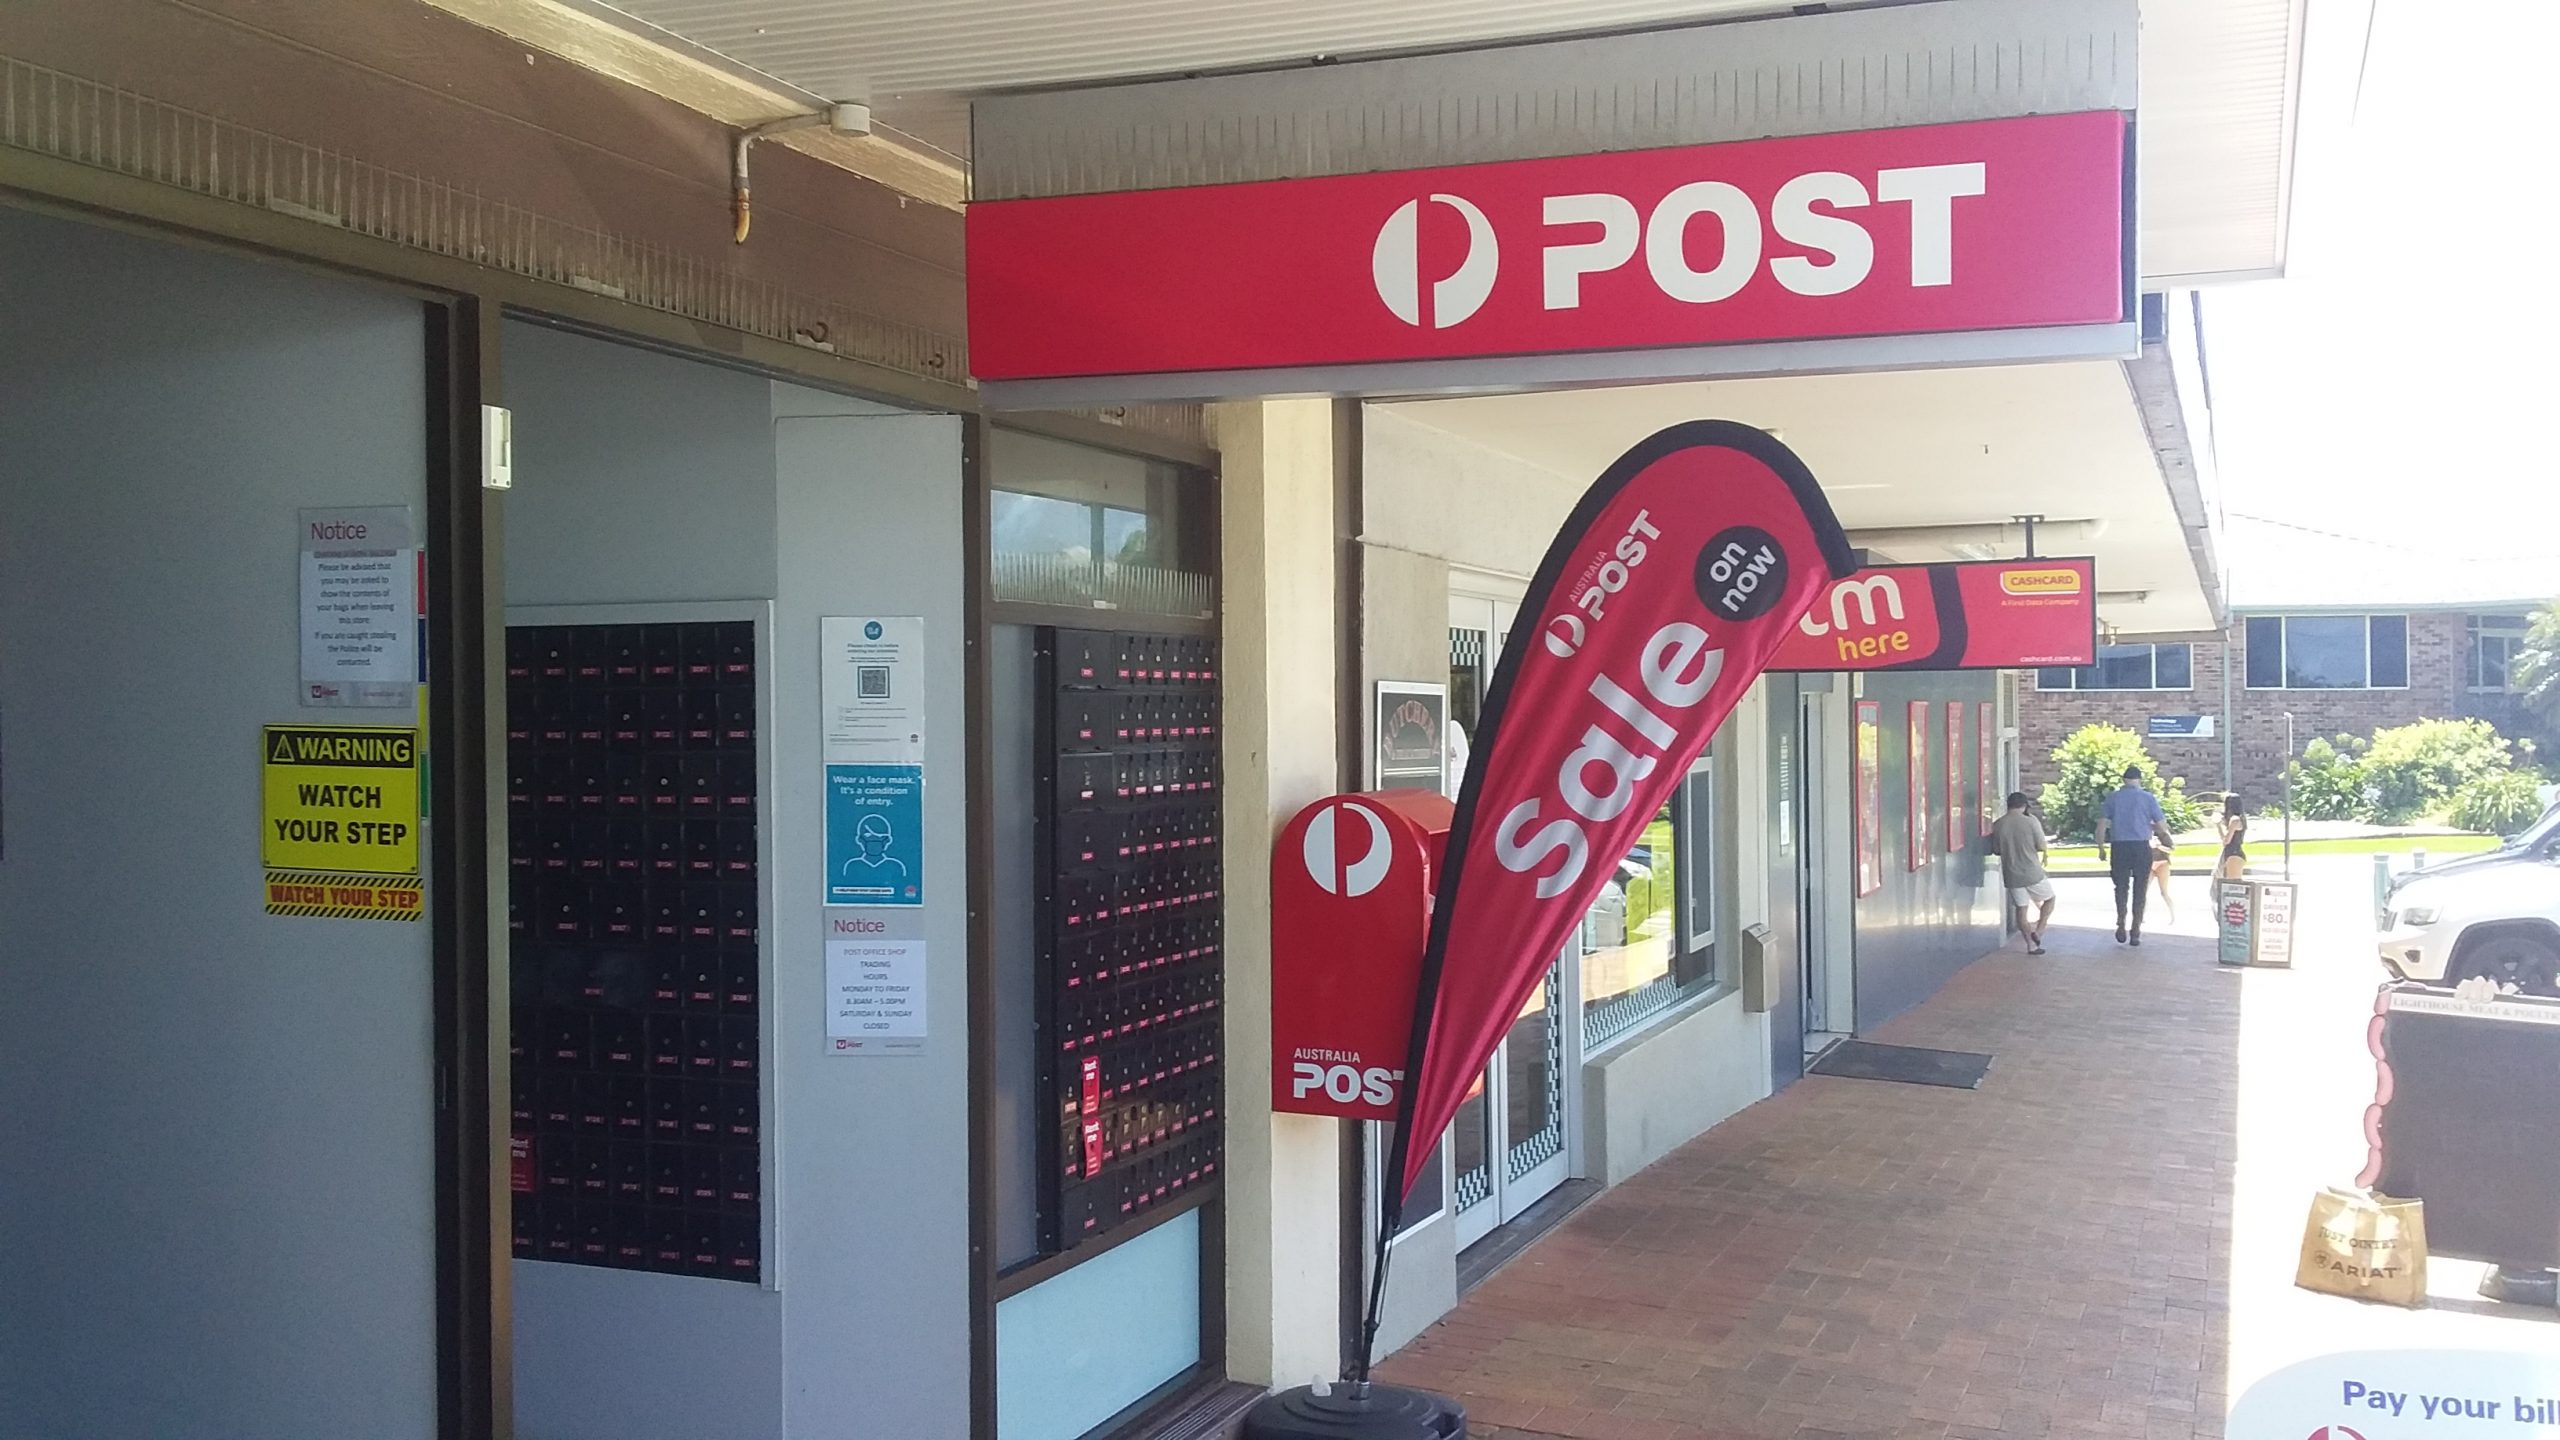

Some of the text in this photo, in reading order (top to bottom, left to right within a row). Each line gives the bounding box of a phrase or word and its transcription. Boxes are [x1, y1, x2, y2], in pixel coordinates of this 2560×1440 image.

[1543, 162, 1986, 311] POST
[311, 521, 366, 540] Notice
[1577, 509, 1661, 622] POST
[1709, 542, 1748, 583] on
[1568, 551, 1608, 603] AUSTRALIA
[1721, 544, 1777, 613] now
[2010, 575, 2074, 586] CASHCARD
[1837, 630, 1910, 661] here
[296, 736, 411, 763] WARNING
[1495, 621, 1725, 900] Sale
[833, 775, 857, 784] Wear
[866, 775, 886, 784] face
[888, 775, 916, 784] mask.
[840, 787, 855, 795] It's
[864, 786, 908, 795] condition
[298, 783, 381, 809] WATCH
[854, 797, 894, 807] of entry.
[274, 818, 407, 846] YOUR STEP
[270, 885, 419, 909] WATCH YOUR STEP
[834, 918, 885, 933] Notice
[2392, 996, 2465, 1012] LIGHTHOUSE
[2468, 1004, 2499, 1015] MEAT
[1293, 1047, 1361, 1063] AUSTRALIA
[2331, 1261, 2397, 1279] ARIAT
[2343, 1380, 2408, 1417] Pay
[2419, 1395, 2502, 1420] your
